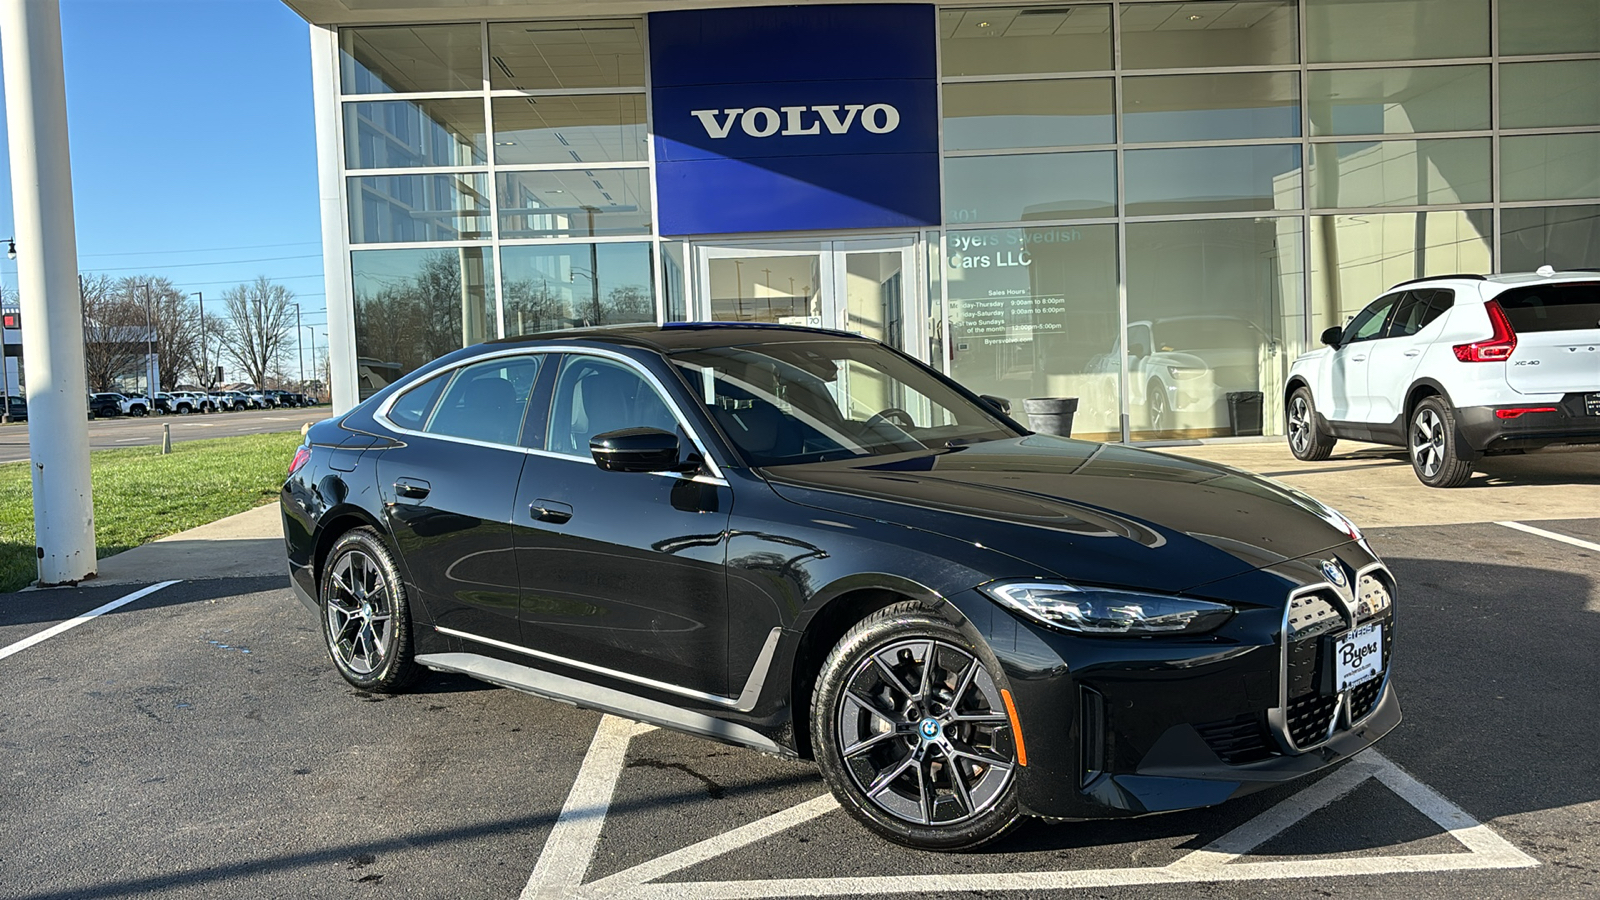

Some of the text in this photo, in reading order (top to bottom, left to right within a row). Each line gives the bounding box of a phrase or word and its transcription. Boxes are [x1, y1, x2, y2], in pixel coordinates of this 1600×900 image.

[691, 103, 900, 139] VOLVO
[949, 229, 1081, 251] Byers Swedish
[948, 251, 1032, 269] Cars LLC
[809, 317, 819, 325] 70
[1338, 642, 1377, 668] Byers
